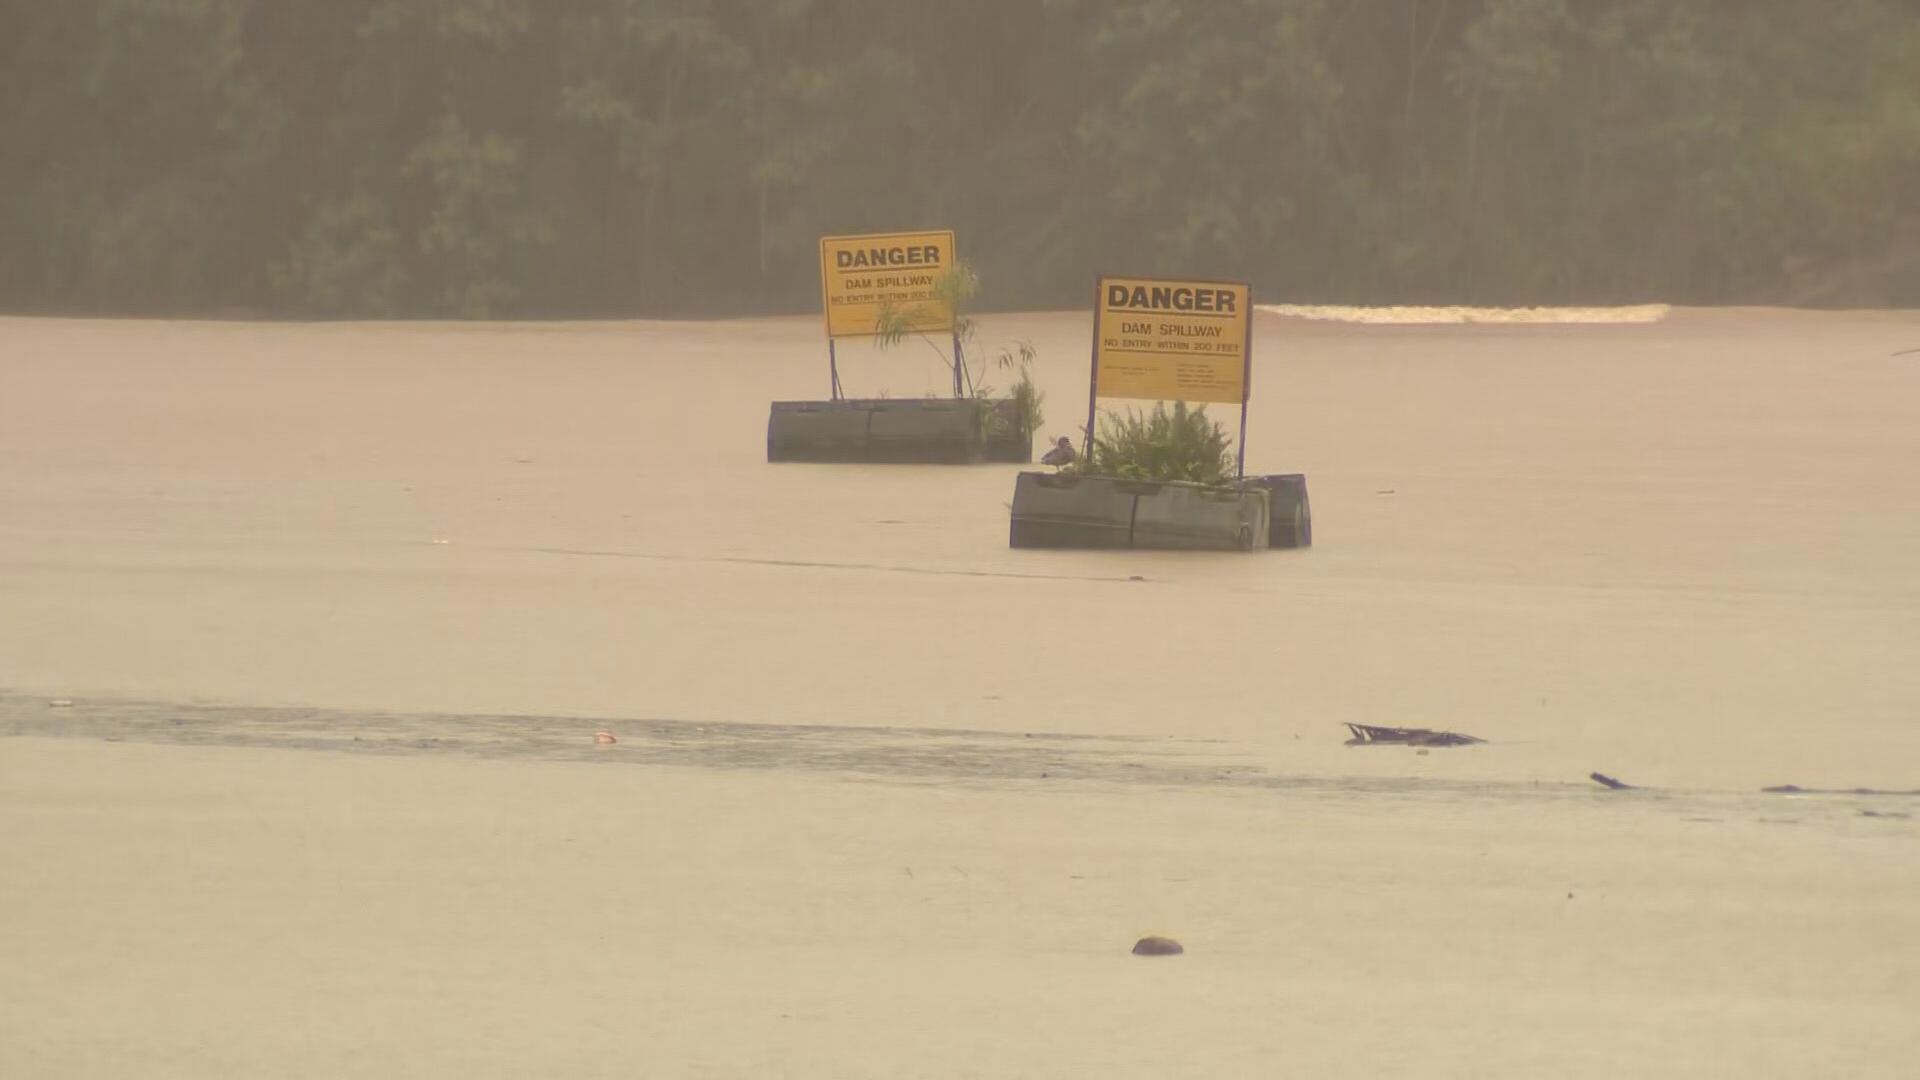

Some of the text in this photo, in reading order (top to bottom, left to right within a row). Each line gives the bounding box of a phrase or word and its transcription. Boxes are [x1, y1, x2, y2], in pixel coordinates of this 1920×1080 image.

[837, 245, 940, 268] DANGER
[846, 275, 934, 290] DAM SPILLWAY
[1108, 285, 1236, 312] DANGER
[1121, 322, 1223, 337] DAM SPILLWAY
[1104, 338, 1239, 353] NO ENTRY WITHIN 200 FEET
